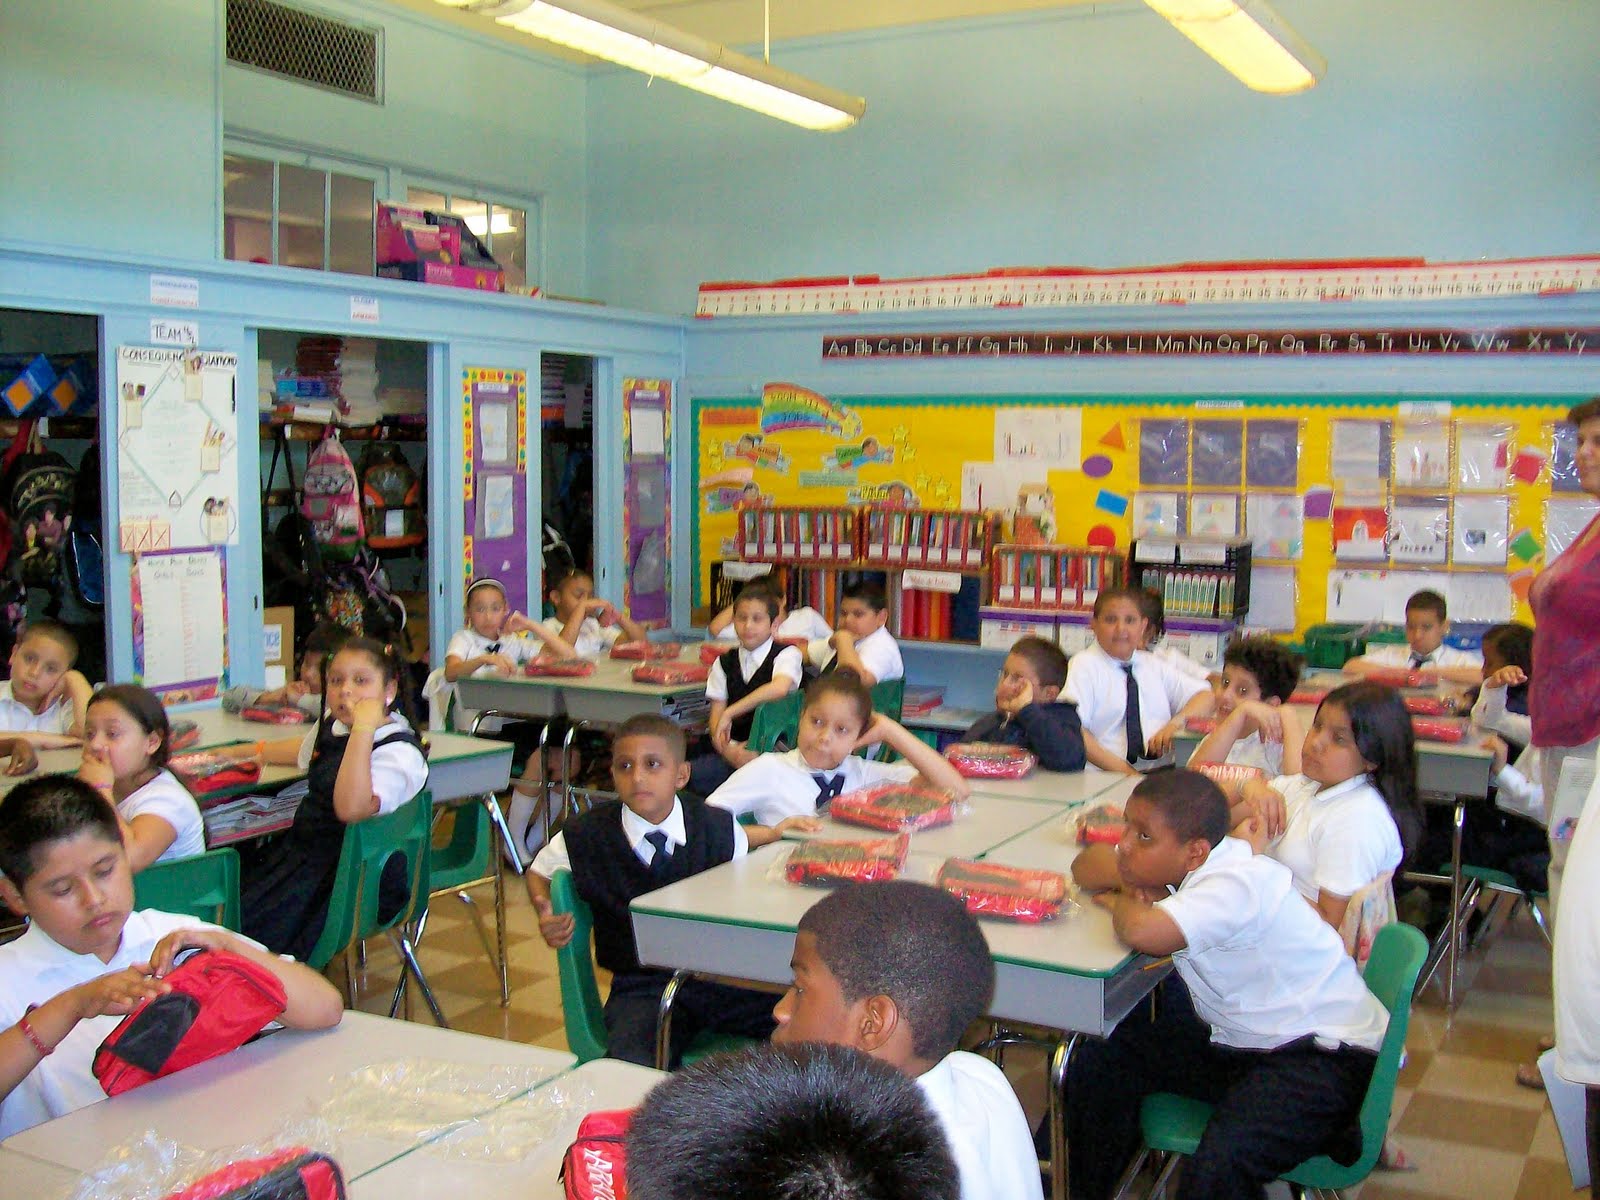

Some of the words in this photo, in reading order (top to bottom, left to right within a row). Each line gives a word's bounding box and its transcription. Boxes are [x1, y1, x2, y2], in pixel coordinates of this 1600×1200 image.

[152, 323, 182, 341] TEAM
[828, 340, 848, 356] Aa
[854, 338, 872, 356] Bb
[878, 338, 897, 354] Cc
[903, 337, 922, 354] Dd
[979, 336, 1000, 358] Gg
[1008, 336, 1028, 353] Hh
[1064, 335, 1081, 355] Jj
[1093, 335, 1113, 353] Kk
[1126, 335, 1143, 353] Ll
[1156, 334, 1185, 353] Mm
[1189, 334, 1212, 353] Nn
[1217, 333, 1240, 352] Oo
[1247, 333, 1268, 357] Pp
[1280, 333, 1308, 355] Qq
[1319, 333, 1338, 352] Rr
[1409, 332, 1430, 352] Uu
[1439, 332, 1460, 352] Vv
[1471, 333, 1510, 352] Ww
[1527, 331, 1551, 351] Xx
[1564, 331, 1587, 357] Yy
